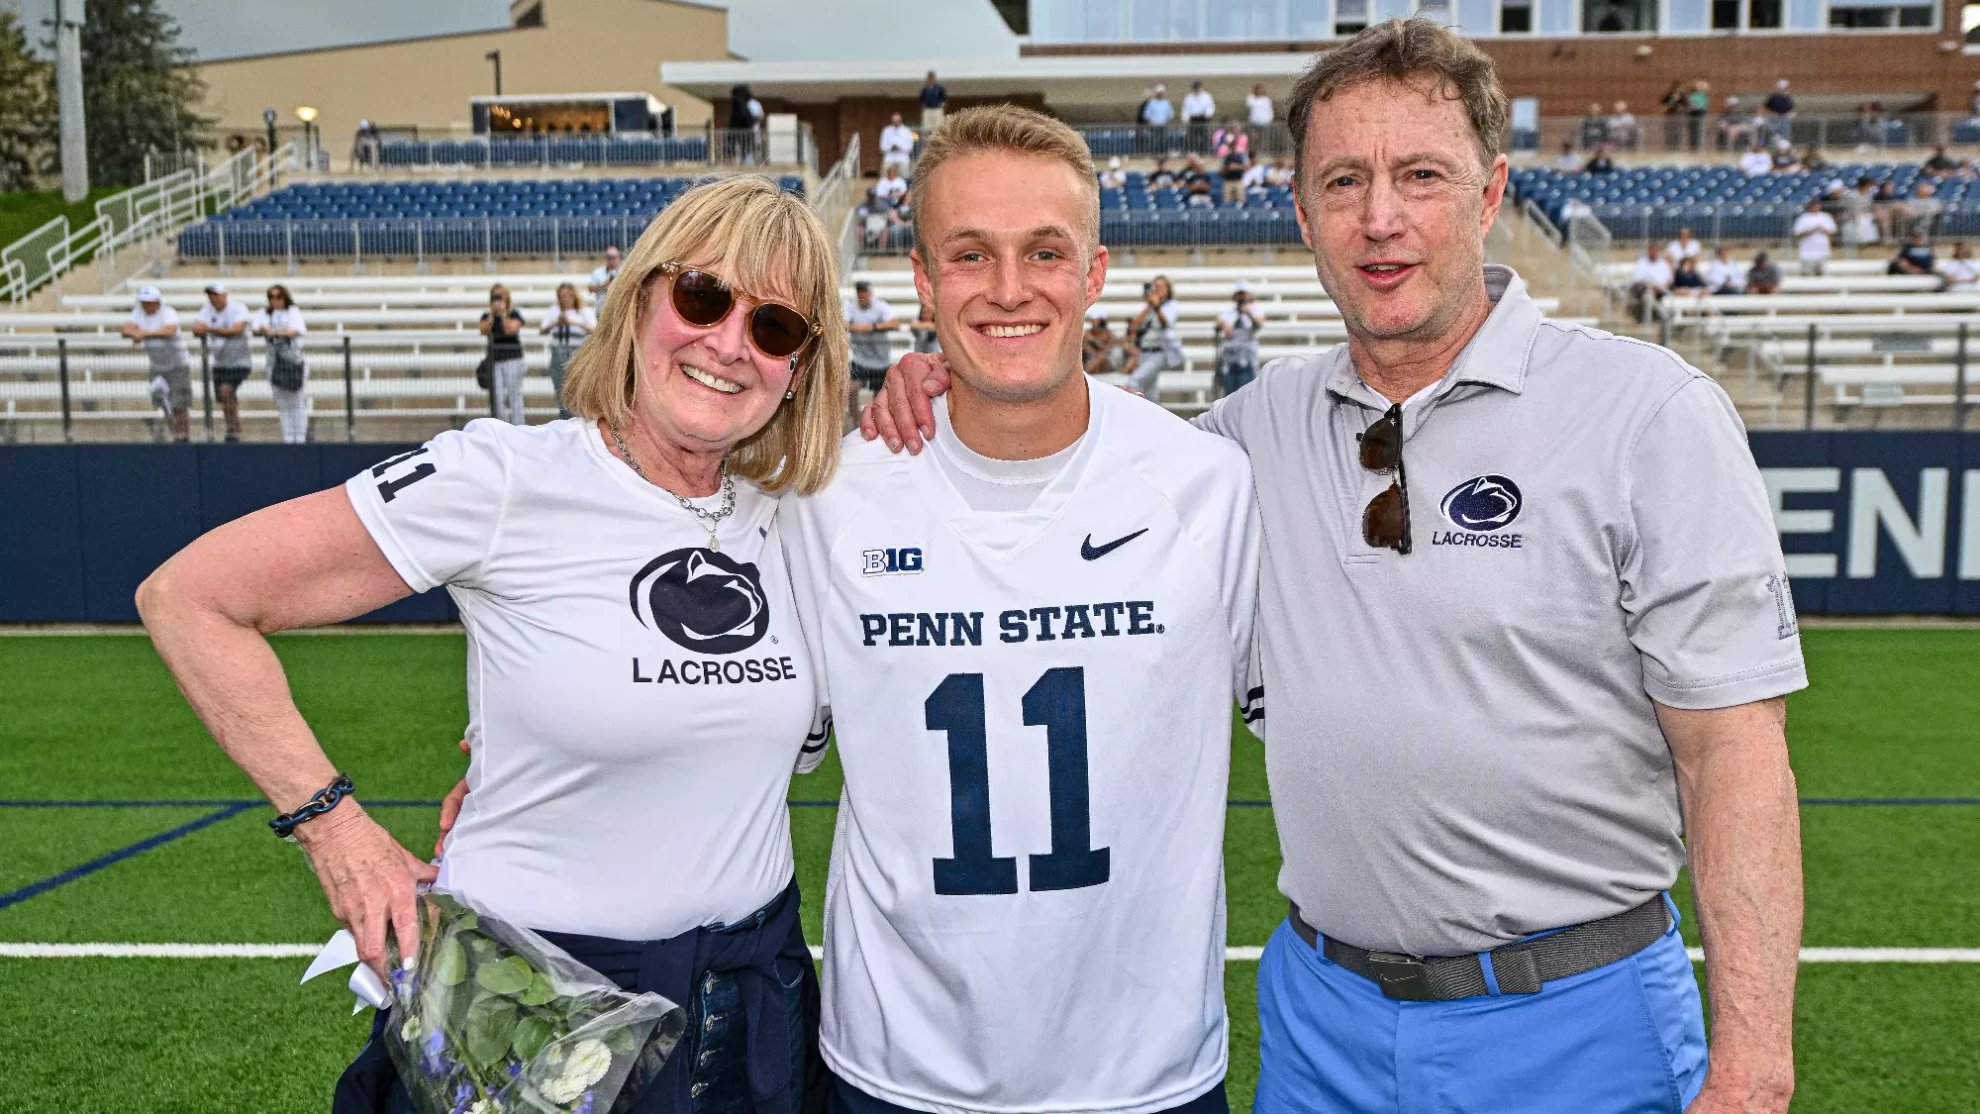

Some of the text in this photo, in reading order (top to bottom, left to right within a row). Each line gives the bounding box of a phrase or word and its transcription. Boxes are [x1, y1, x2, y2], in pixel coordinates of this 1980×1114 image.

[1432, 531, 1522, 549] LACROSSE
[1760, 467, 1980, 580] EN
[860, 600, 1155, 646] PENN STATE
[632, 656, 797, 685] LACROSSE
[924, 666, 1111, 895] 11
